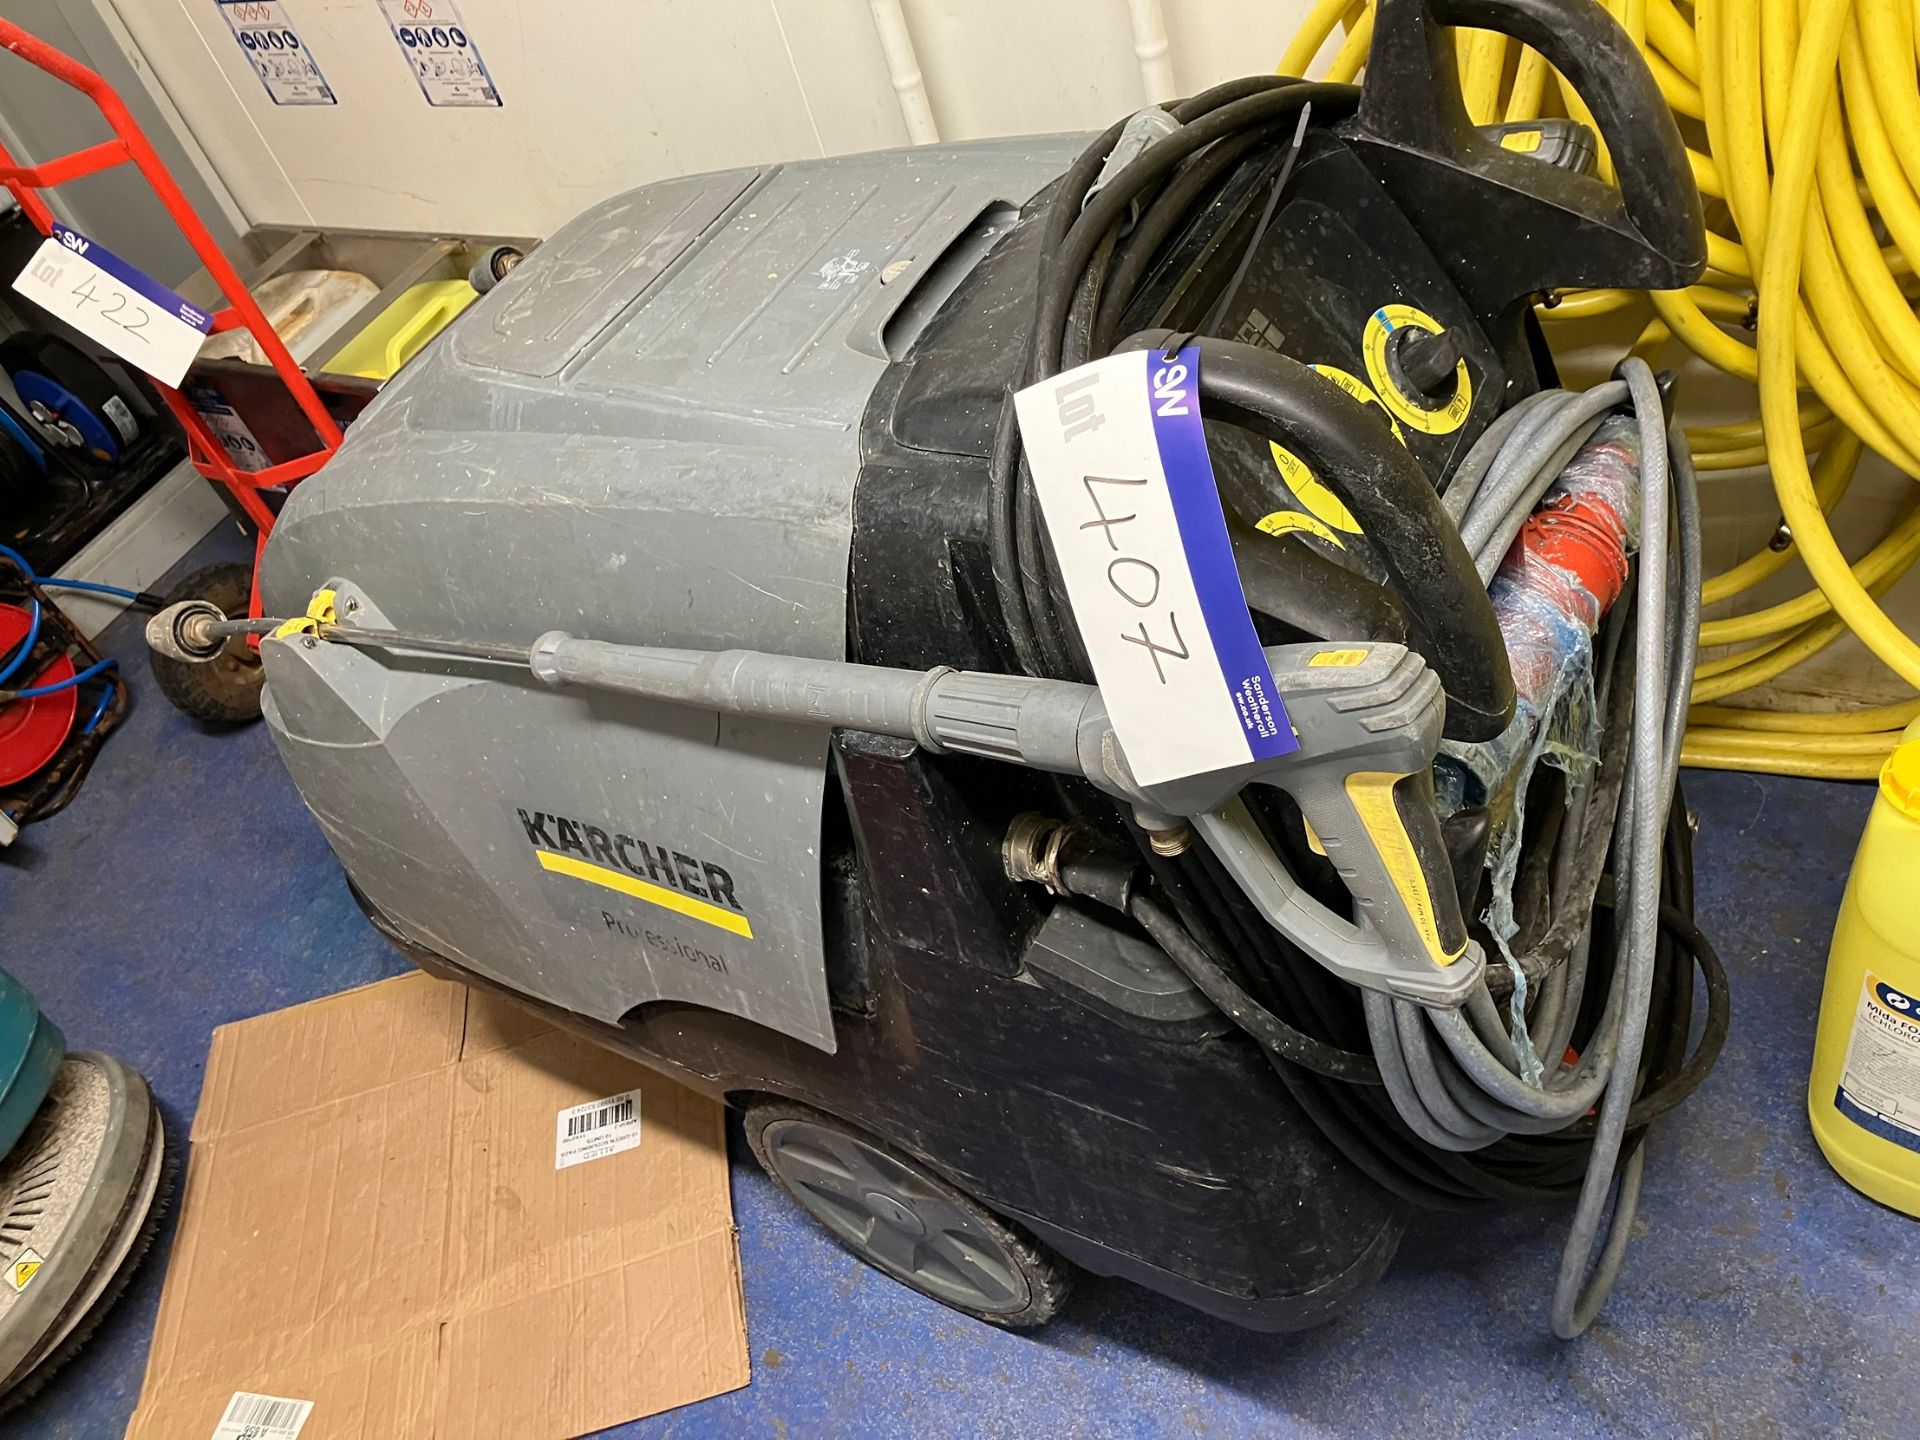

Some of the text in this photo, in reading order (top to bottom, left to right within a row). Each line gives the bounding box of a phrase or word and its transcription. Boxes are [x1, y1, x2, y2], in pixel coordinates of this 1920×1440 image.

[30, 255, 64, 288] Lot
[72, 273, 150, 344] 422
[1055, 372, 1105, 443] Lot
[1153, 363, 1188, 417] SW
[1080, 475, 1189, 684] 407
[1235, 691, 1254, 730] sw.co.uk
[1242, 678, 1270, 738] Weatherall
[1251, 675, 1278, 736] Sanderson
[516, 807, 744, 911] KÄRCHER
[602, 910, 729, 976] Proessional
[1867, 1001, 1897, 1024] Mida
[584, 1145, 615, 1160] ALLIED
